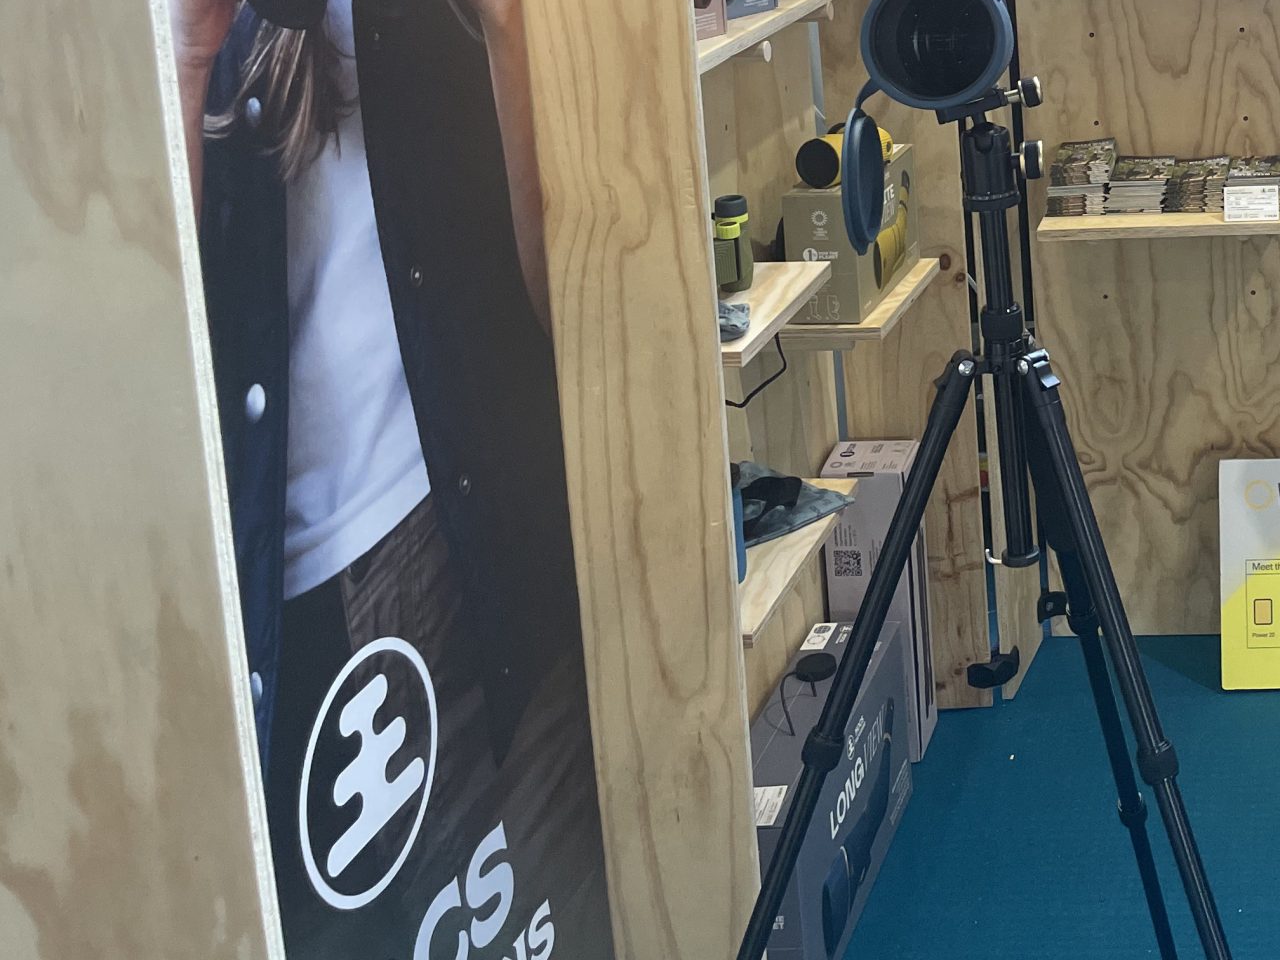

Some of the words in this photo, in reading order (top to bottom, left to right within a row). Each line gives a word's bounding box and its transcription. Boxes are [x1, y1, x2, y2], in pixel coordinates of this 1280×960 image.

[1252, 562, 1272, 571] Meet
[830, 757, 865, 840] LONG
[863, 703, 887, 772] VIEW
